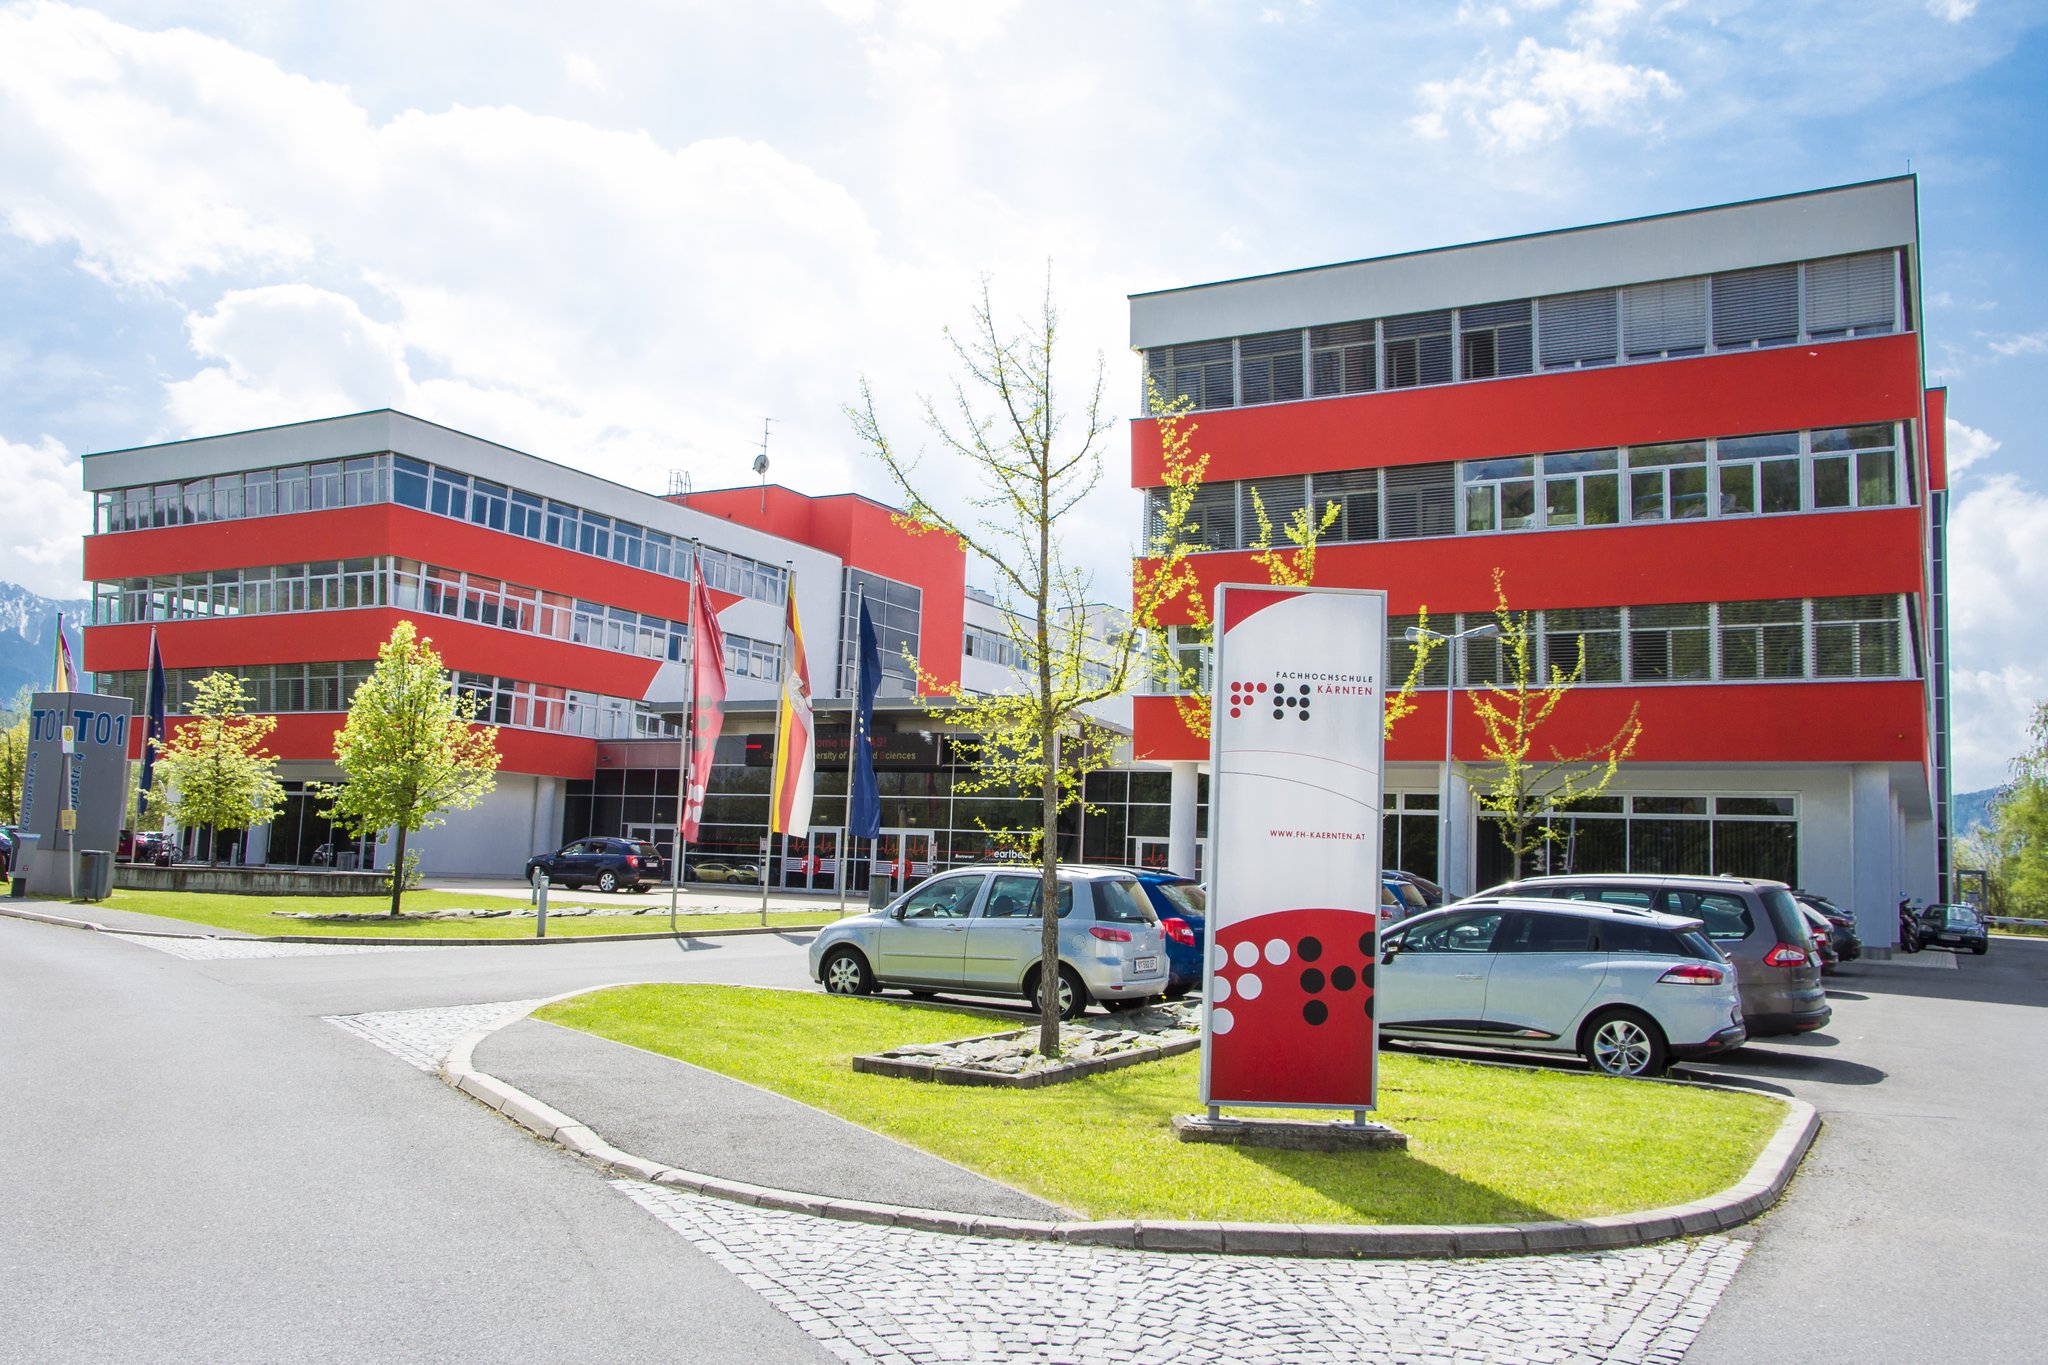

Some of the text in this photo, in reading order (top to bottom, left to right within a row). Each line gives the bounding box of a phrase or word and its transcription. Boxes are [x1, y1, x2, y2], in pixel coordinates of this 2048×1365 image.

[1276, 671, 1373, 683] FACHHOCHSCHULE
[1317, 683, 1373, 696] KÄRNTEN
[73, 708, 126, 747] T01
[880, 751, 917, 760] Sciences
[1270, 829, 1366, 841] WWW.FH-KAERNTEN.AT
